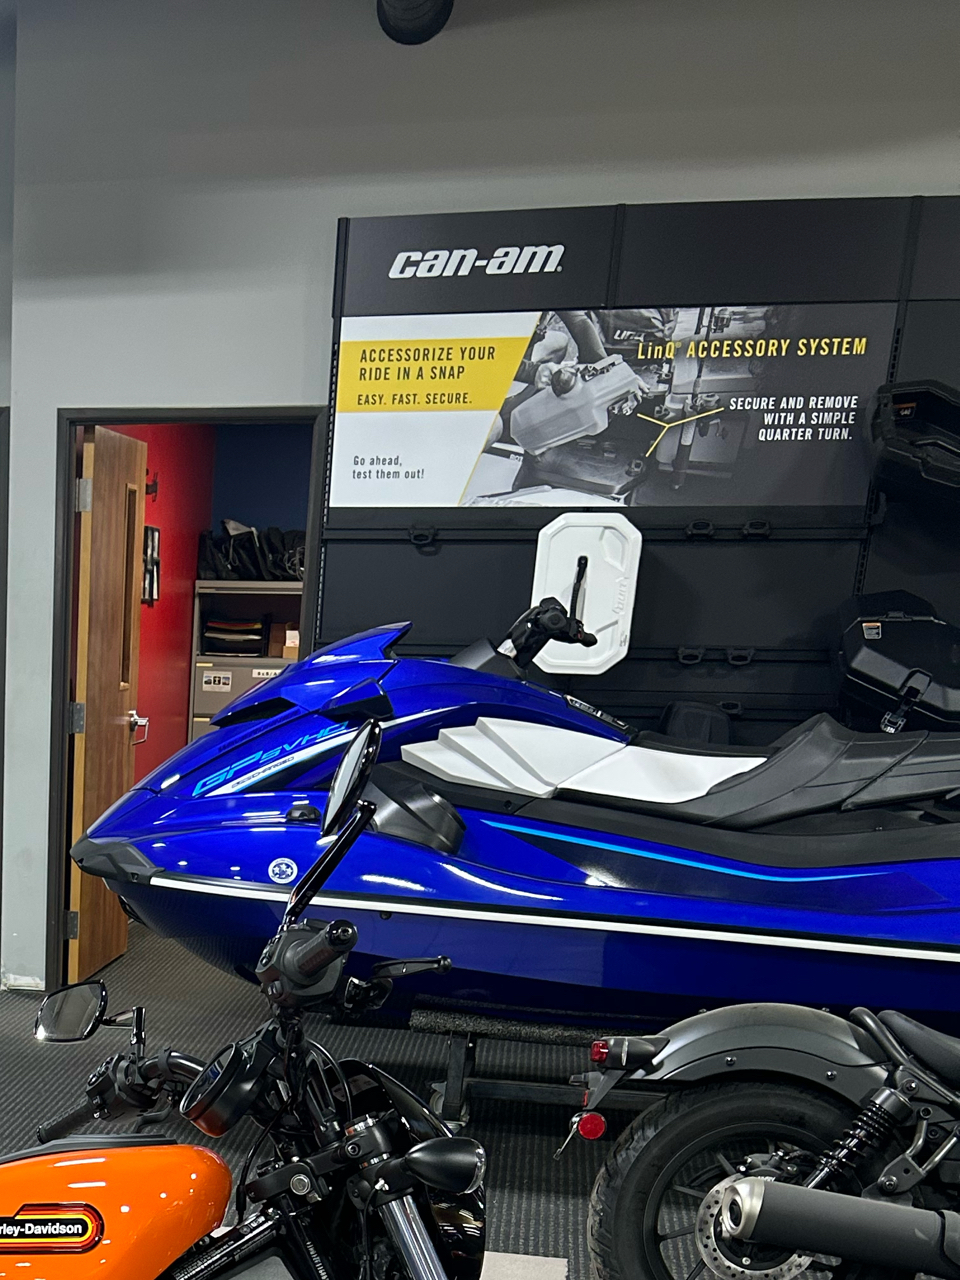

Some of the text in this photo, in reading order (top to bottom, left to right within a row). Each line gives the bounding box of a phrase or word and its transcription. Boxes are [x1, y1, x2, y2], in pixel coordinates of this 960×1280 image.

[388, 243, 565, 280] can-am
[360, 346, 495, 363] ACCESSORIZE YOUR
[686, 338, 790, 358] ACCESSORY
[797, 337, 867, 356] SYSTEM
[359, 365, 465, 381] RIDE IN A SNAP
[357, 392, 473, 406] EASY. FAST. SECURE.
[729, 395, 858, 410] SECURE AND REMOVE
[764, 412, 856, 425] WITH A SIMPLE
[758, 427, 853, 441] QUARTER TURN.
[353, 455, 403, 467] Go ahead,
[352, 468, 425, 479] test them out!
[192, 750, 263, 797] GP
